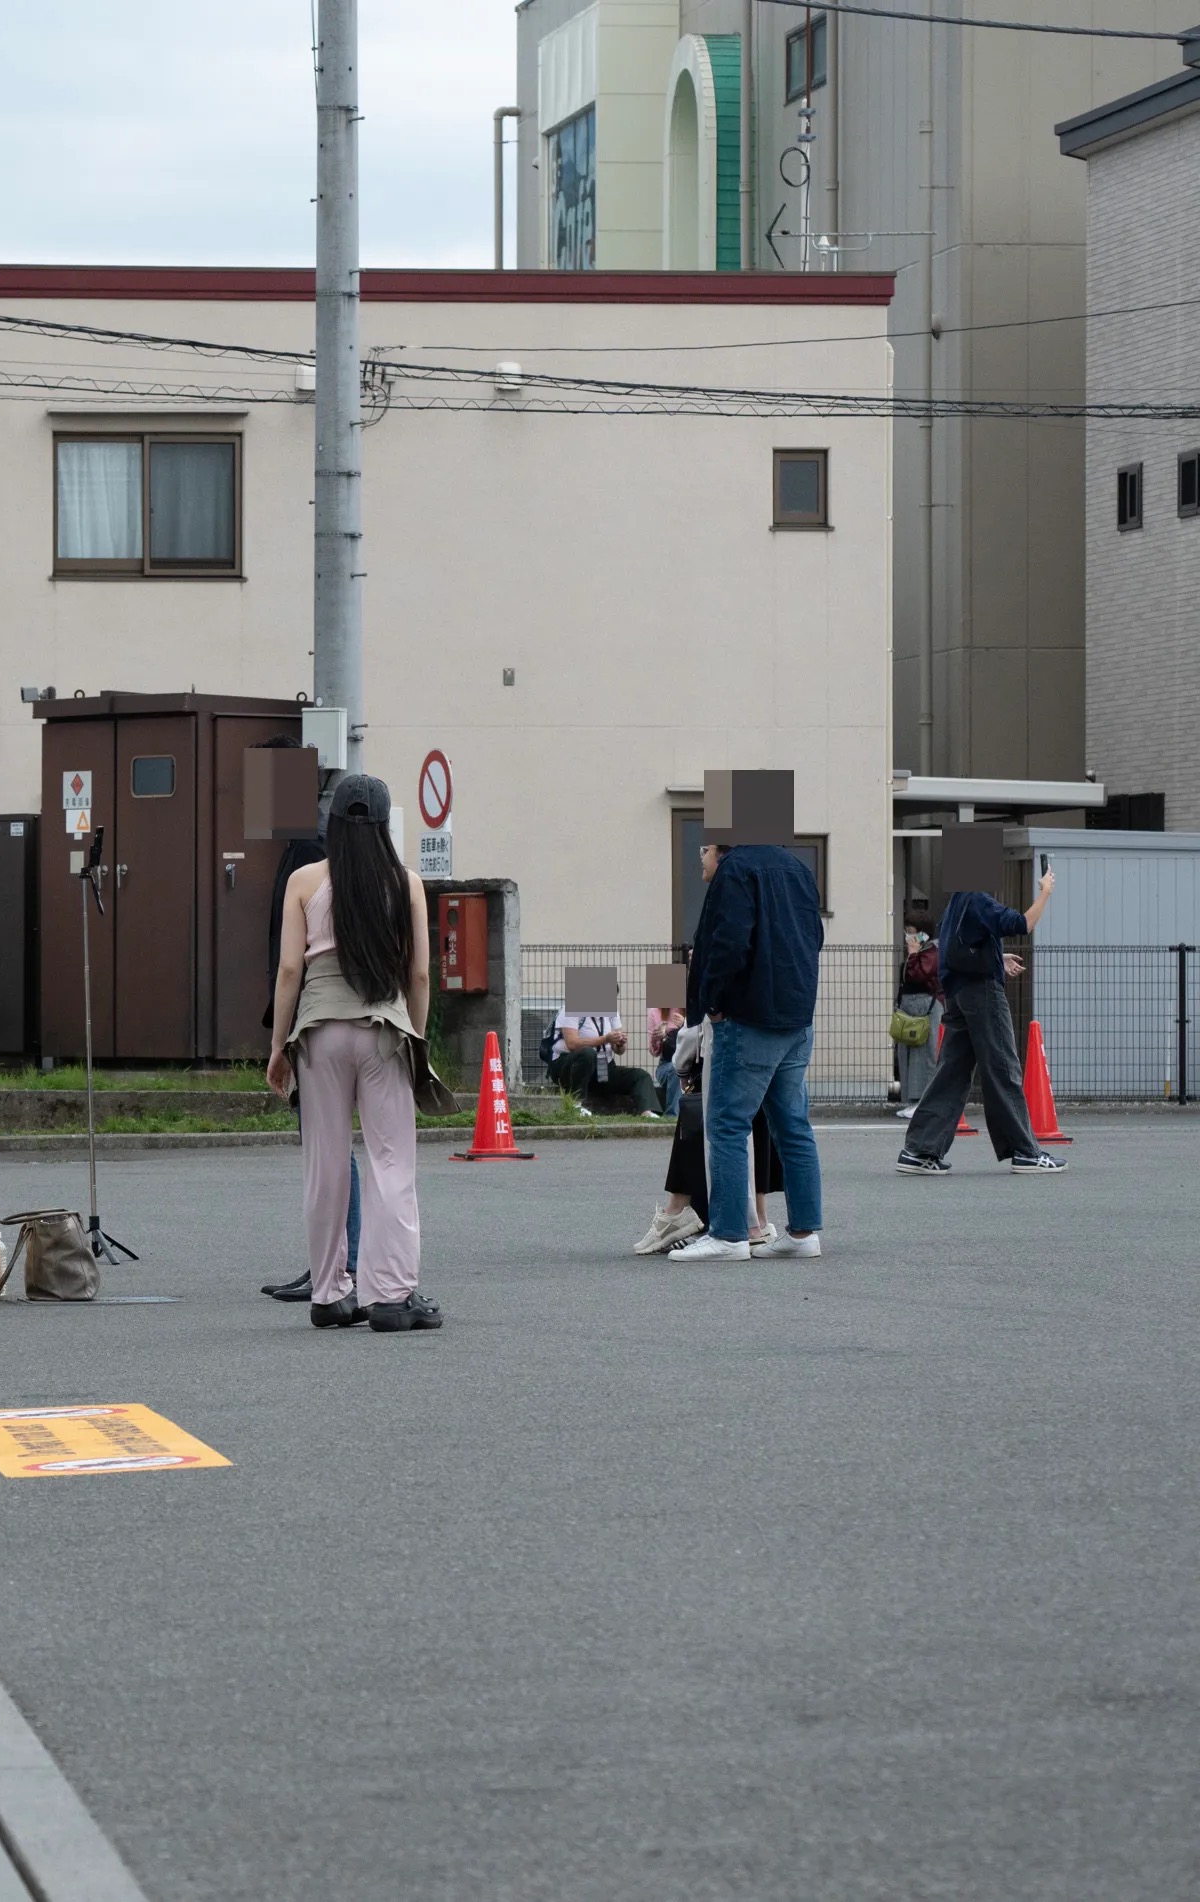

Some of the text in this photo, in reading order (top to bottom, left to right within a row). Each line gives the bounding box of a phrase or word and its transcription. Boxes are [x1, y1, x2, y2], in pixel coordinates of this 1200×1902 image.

[448, 930, 457, 965] 消火器
[489, 1058, 509, 1134] 駐車禁止
